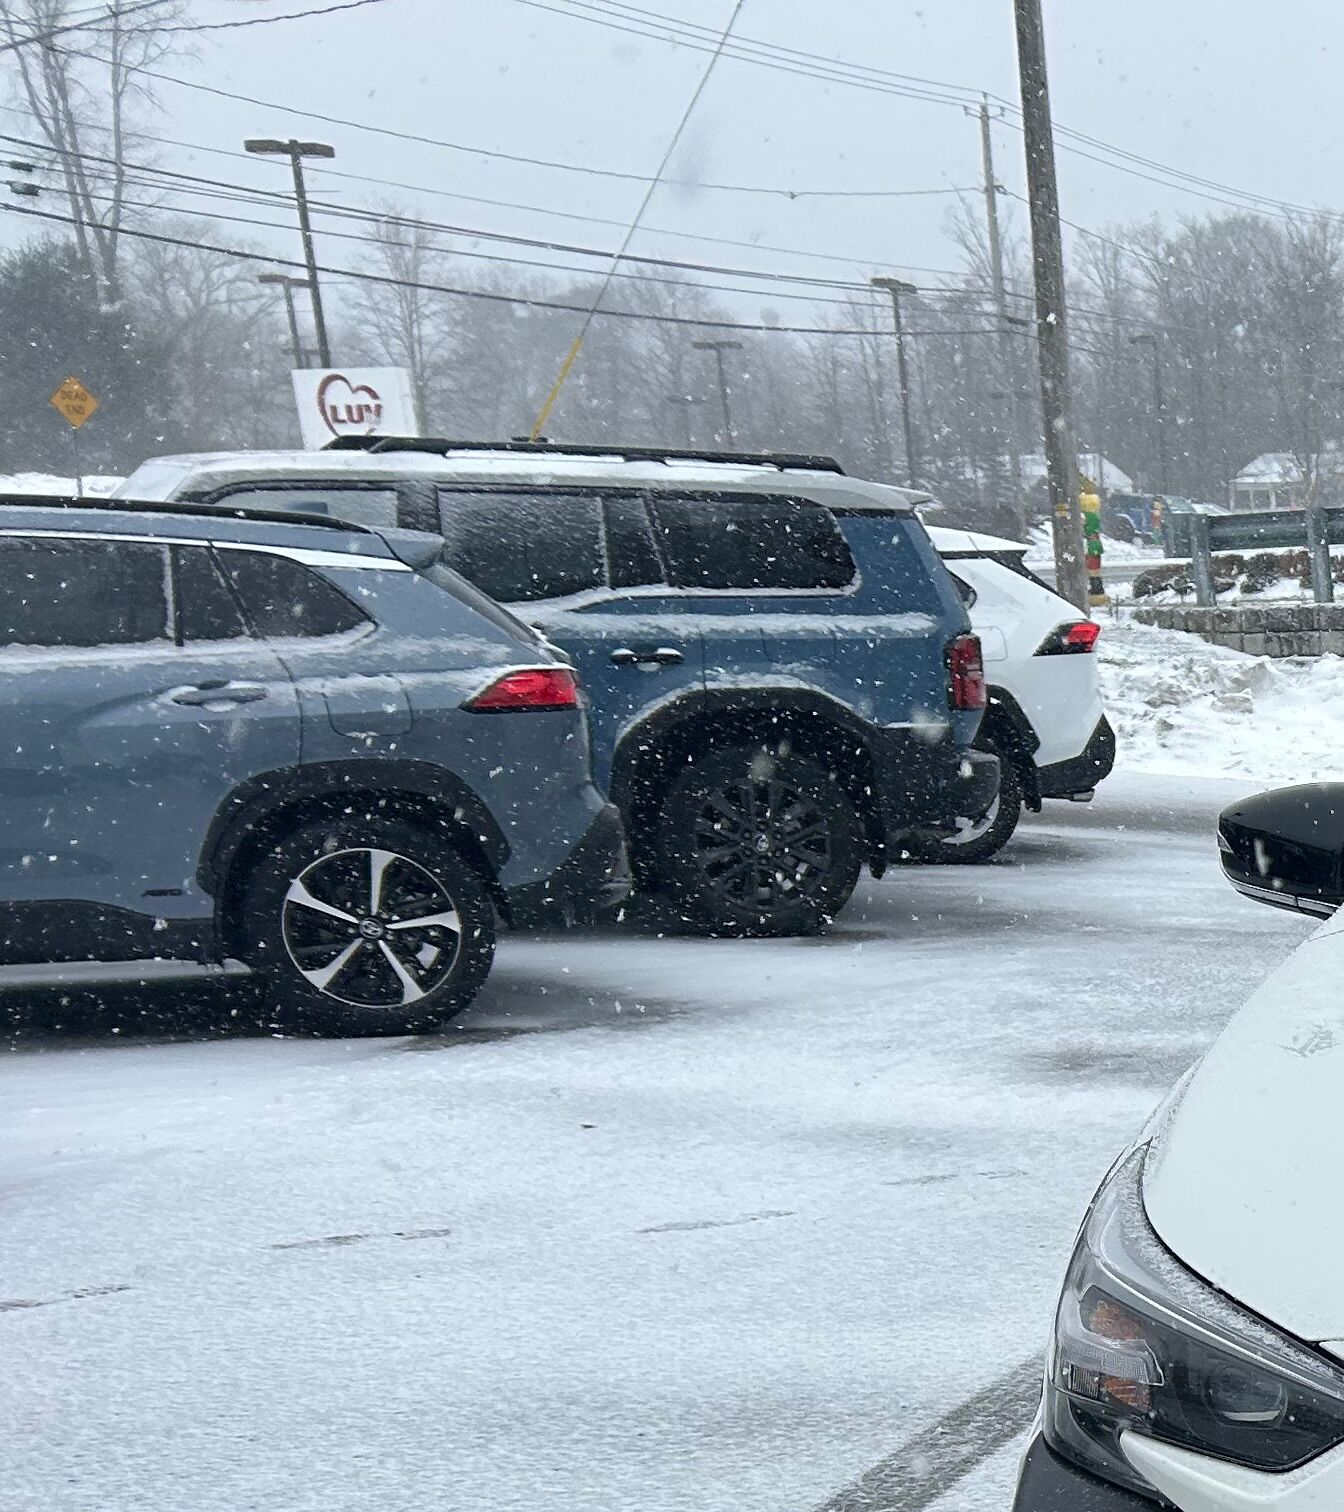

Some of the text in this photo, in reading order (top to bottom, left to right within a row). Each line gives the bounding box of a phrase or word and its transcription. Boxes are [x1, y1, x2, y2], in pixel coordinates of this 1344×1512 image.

[60, 390, 87, 402] DEAD
[65, 404, 85, 416] END
[330, 403, 383, 424] LUV
